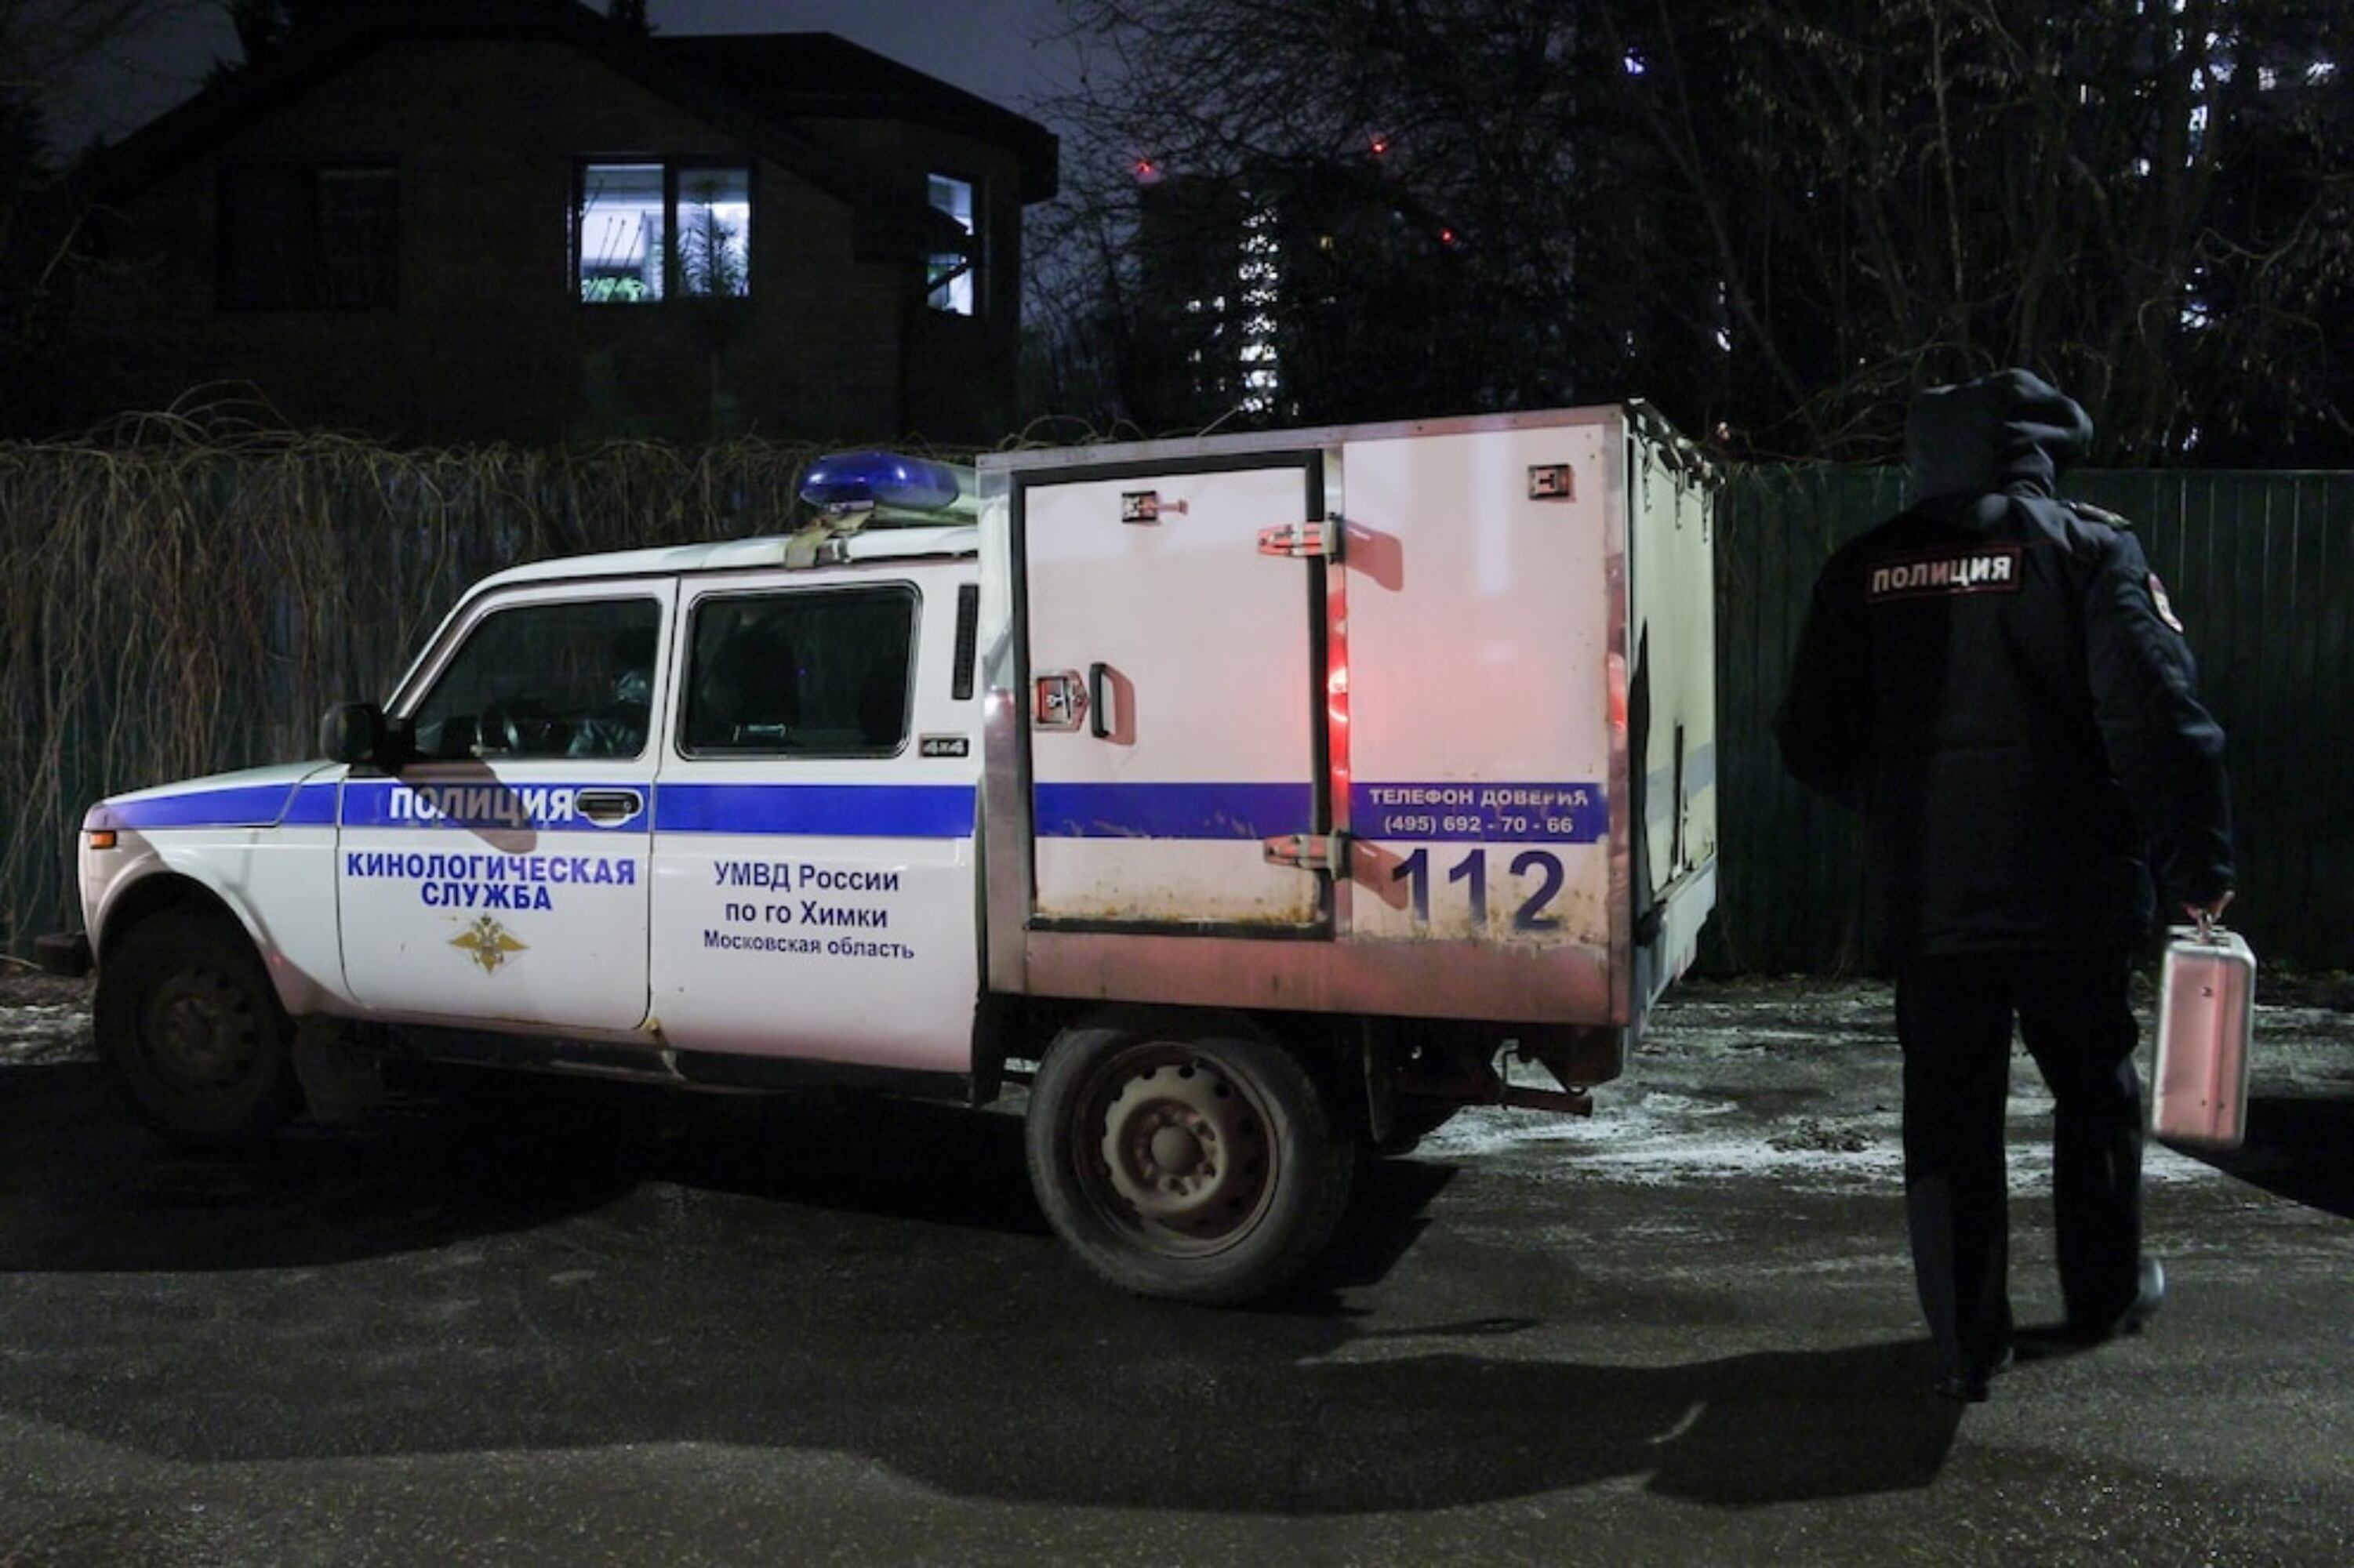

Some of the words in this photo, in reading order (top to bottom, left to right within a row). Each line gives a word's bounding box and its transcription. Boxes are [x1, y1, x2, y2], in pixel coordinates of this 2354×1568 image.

[1872, 555, 2012, 593] ПОЛИЦИЯ
[389, 786, 574, 827] ПОЛИЦИЯ
[1368, 788, 1474, 805] ТЕЛЕФОН
[1384, 815, 1437, 835] (495)
[1443, 816, 1481, 833] 692
[1501, 817, 1527, 833] 70
[1546, 817, 1574, 833] 66
[347, 852, 636, 886] КИНОЛОГИЧЕСКАЯ
[714, 862, 791, 892] УМВД
[798, 866, 899, 891] России
[421, 880, 552, 911] СЛУЖБА
[1393, 848, 1565, 933] 112
[725, 902, 757, 922] по
[765, 904, 792, 924] го
[800, 901, 888, 928] Химки
[703, 930, 822, 955] Московская
[827, 935, 915, 960] область
